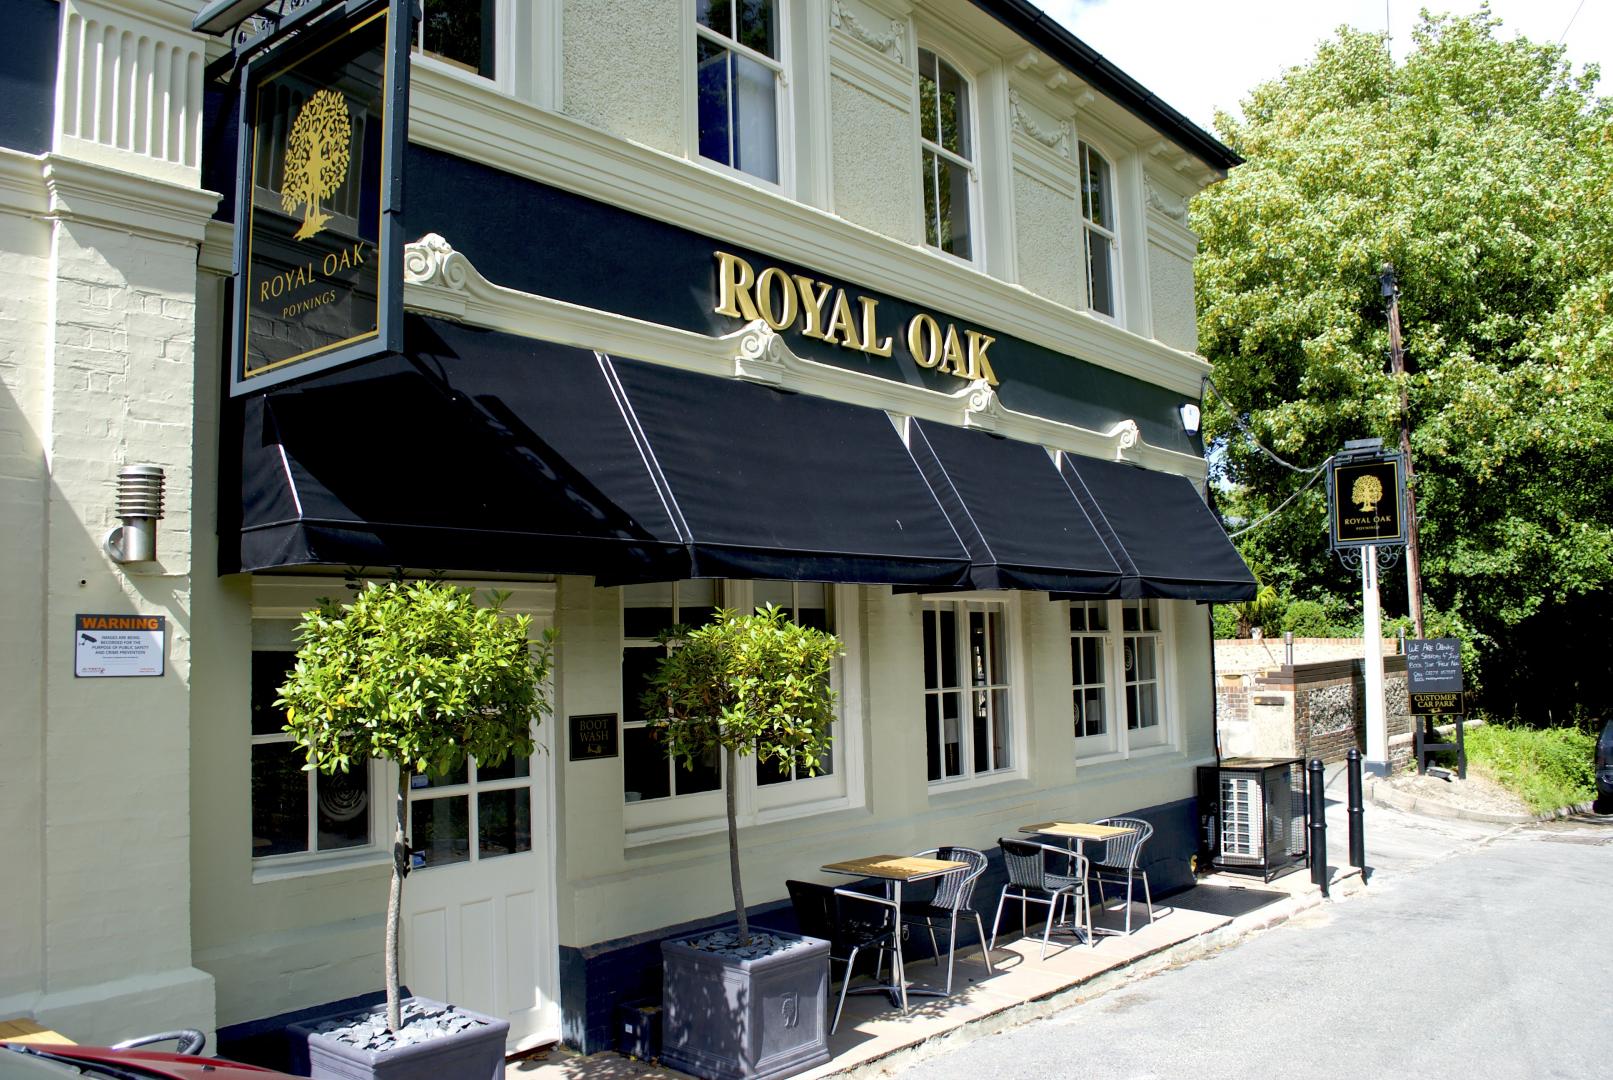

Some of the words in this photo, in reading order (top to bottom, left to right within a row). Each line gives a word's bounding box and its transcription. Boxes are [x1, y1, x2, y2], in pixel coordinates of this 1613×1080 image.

[260, 262, 316, 302] ROYAL
[323, 242, 364, 276] OAK
[283, 290, 336, 319] POYNINGS
[713, 251, 893, 358] ROYAL
[908, 313, 999, 386] OAK
[82, 617, 159, 630] WARNING
[1414, 694, 1457, 702] CUSTOMER
[580, 719, 608, 731] BOOT
[580, 730, 608, 742] WASH
